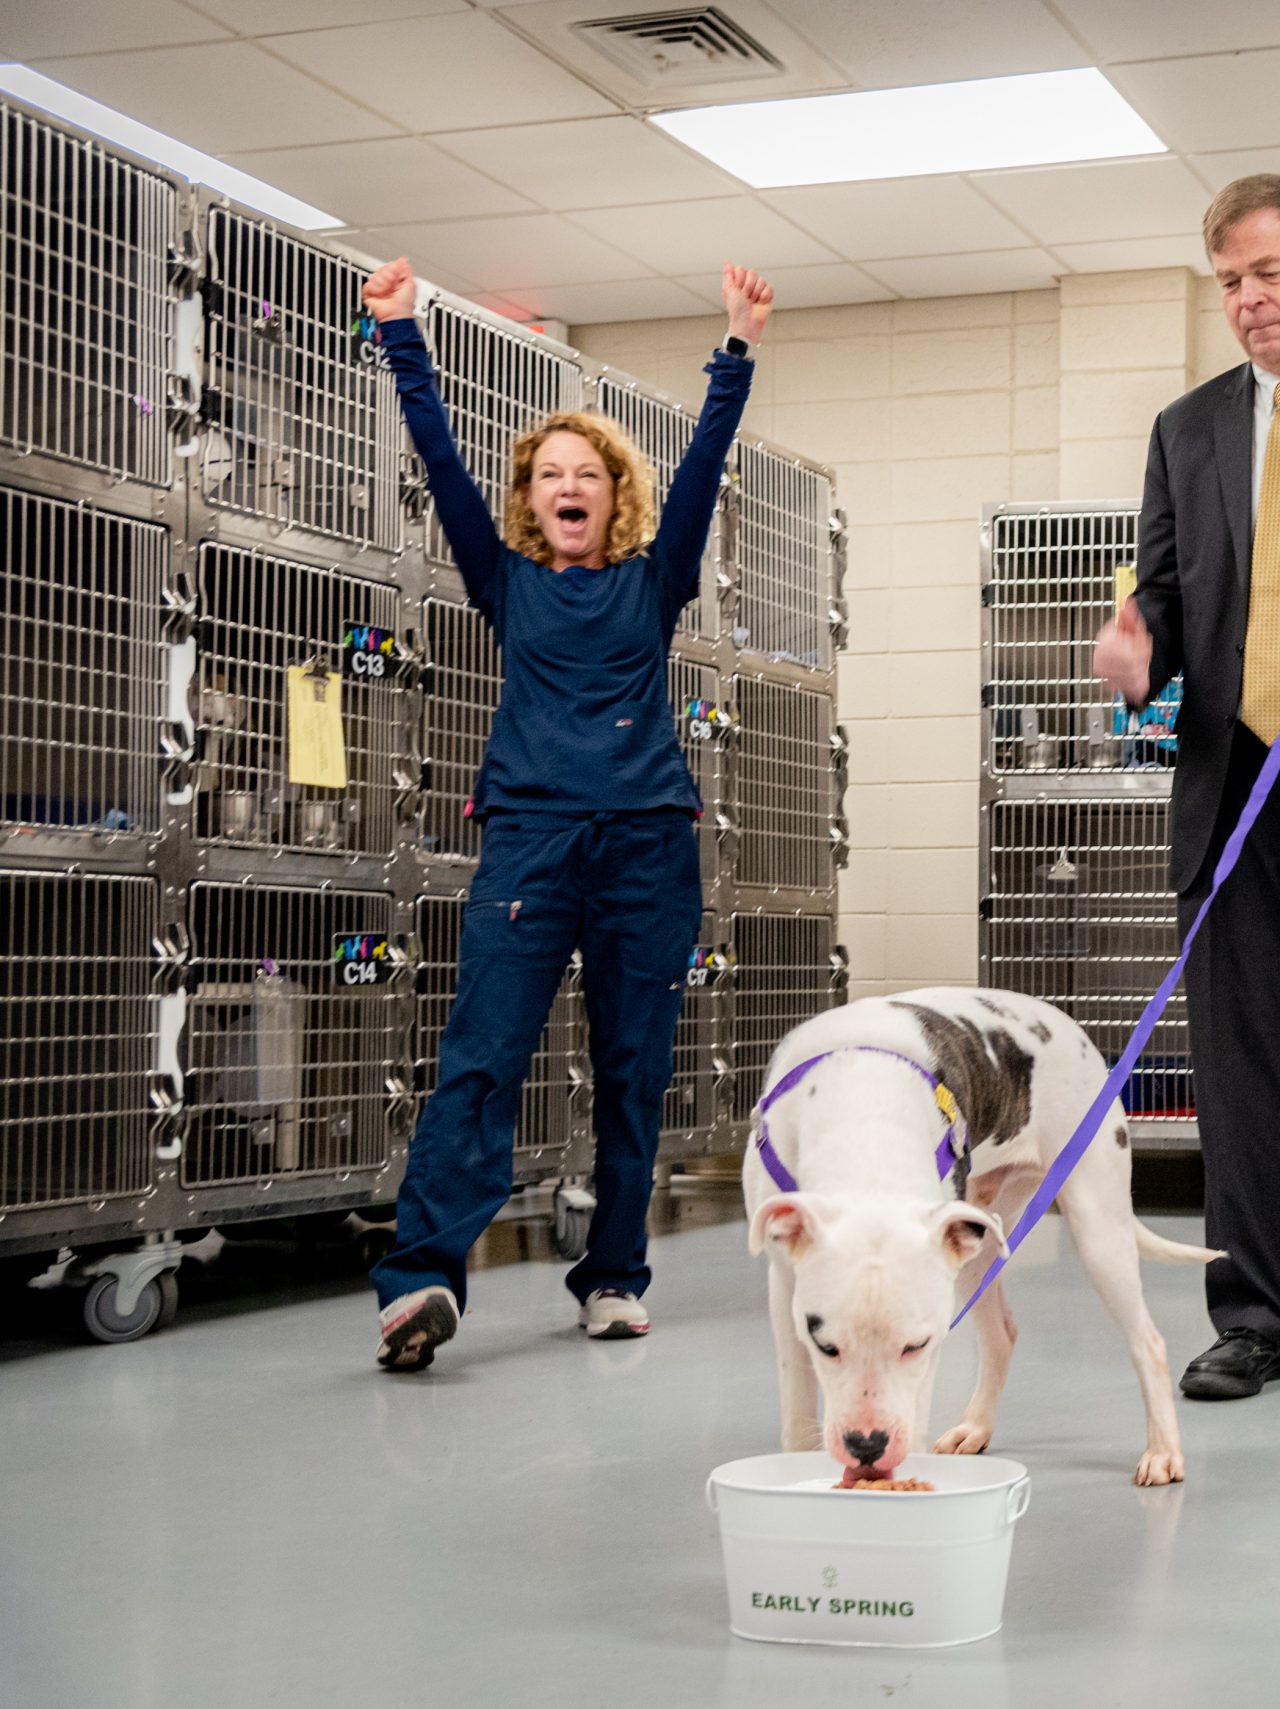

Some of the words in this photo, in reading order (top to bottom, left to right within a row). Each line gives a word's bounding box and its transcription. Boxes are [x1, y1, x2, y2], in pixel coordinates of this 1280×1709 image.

[352, 651, 385, 677] C13
[343, 961, 378, 985] C14
[687, 967, 709, 987] C17
[751, 1592, 821, 1613] EARLY
[828, 1598, 914, 1617] SPRING
